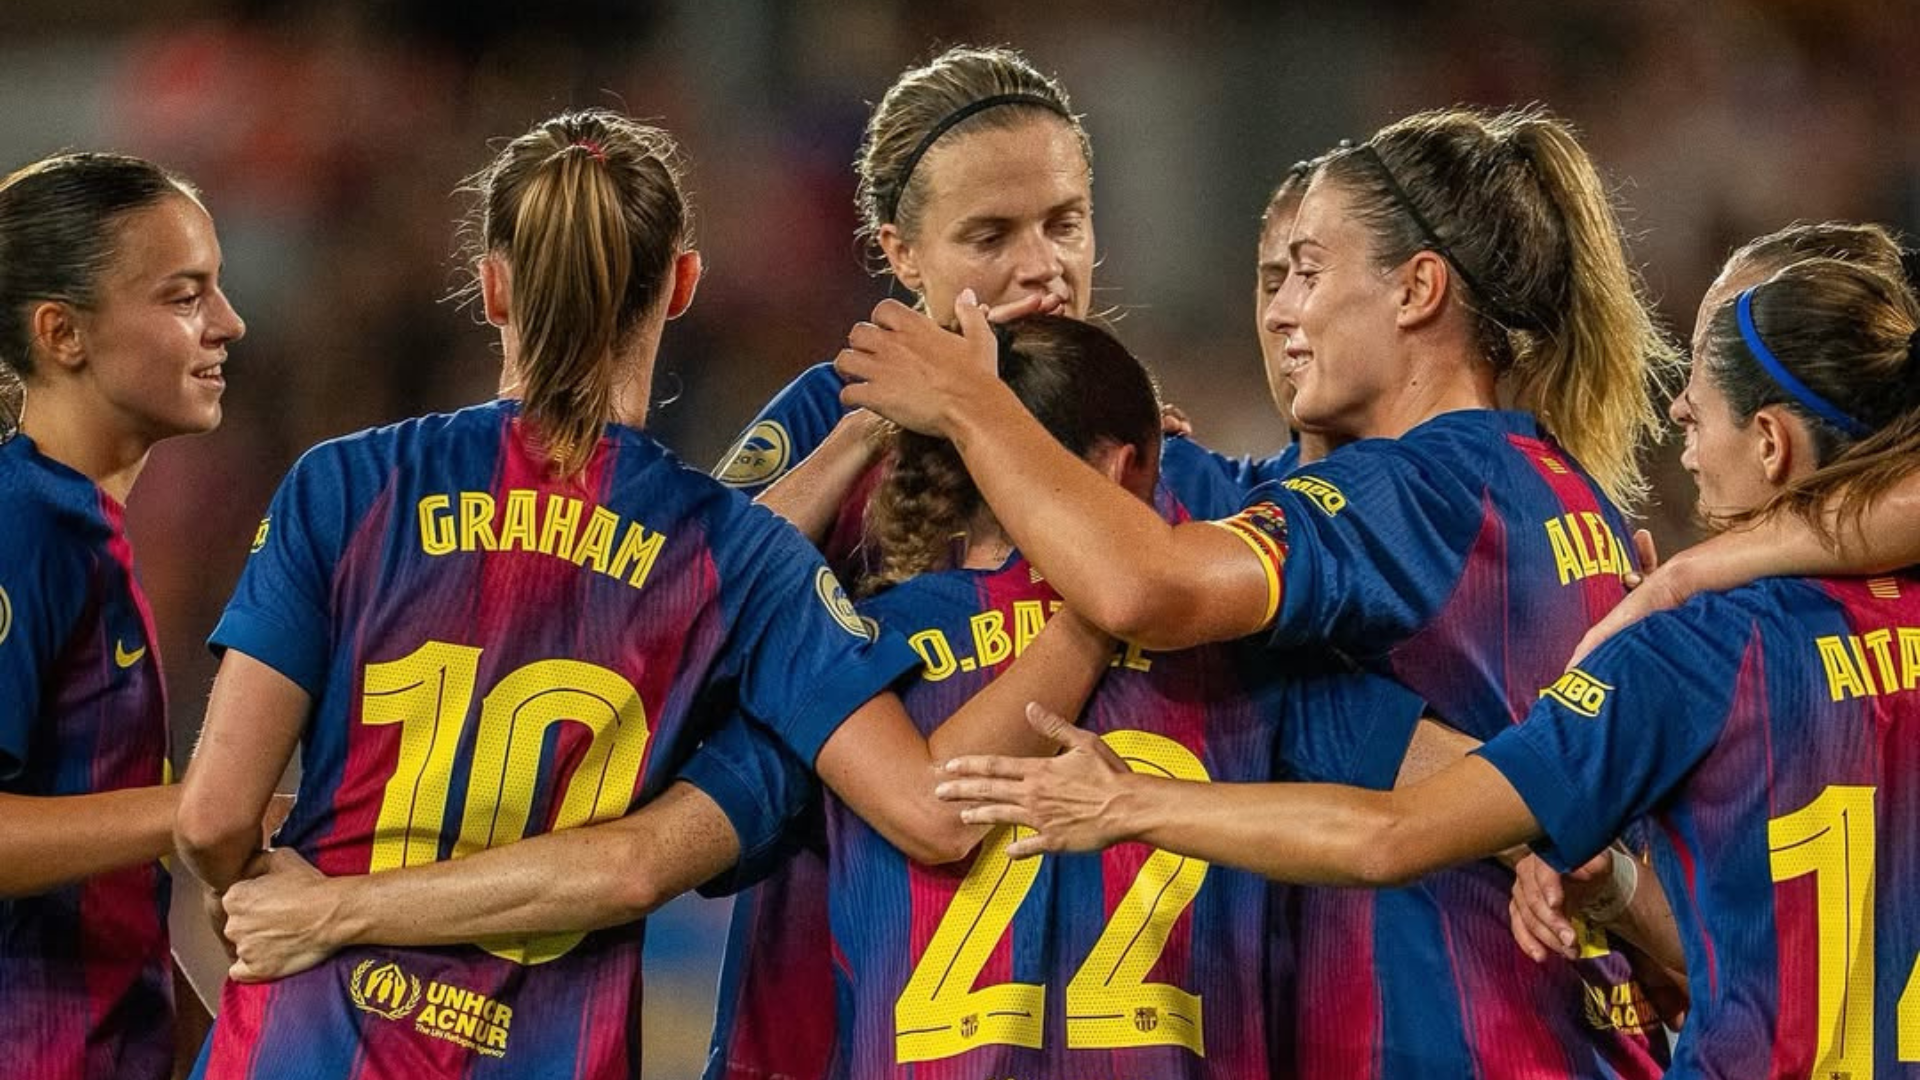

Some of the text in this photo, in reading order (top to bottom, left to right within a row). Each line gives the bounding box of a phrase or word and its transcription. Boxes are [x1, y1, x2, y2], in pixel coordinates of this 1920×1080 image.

[418, 489, 667, 590] GRAHAM
[362, 640, 650, 965] 10
[895, 729, 1211, 1064] 22
[416, 1003, 509, 1050] ACNUR
[426, 981, 513, 1029] UNHCR
[1767, 785, 1920, 1080] 1
